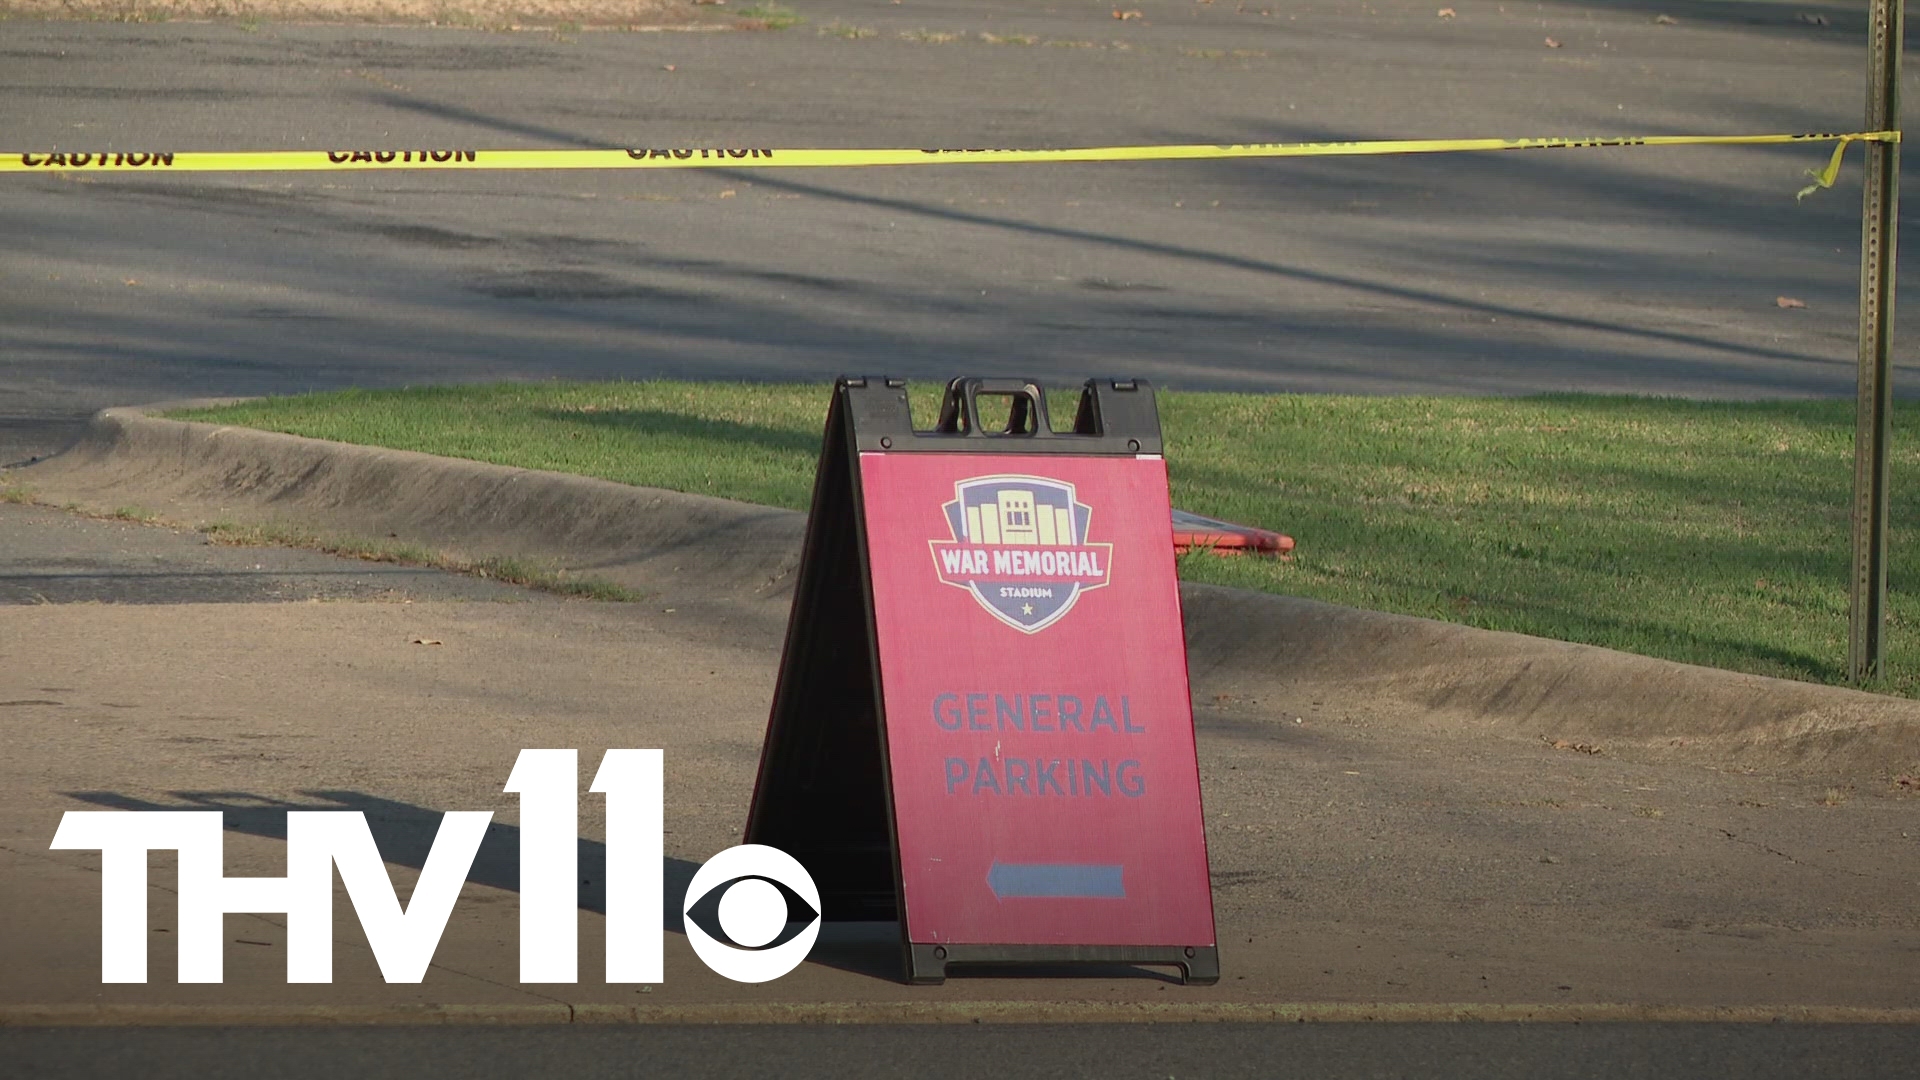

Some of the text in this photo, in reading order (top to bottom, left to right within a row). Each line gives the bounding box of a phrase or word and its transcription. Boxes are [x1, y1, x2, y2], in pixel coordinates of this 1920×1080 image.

[940, 548, 1104, 577] WAR MEMORIAL
[999, 586, 1052, 599] STADIUM
[932, 692, 1146, 734] GENERAL
[944, 757, 1146, 798] PARKING
